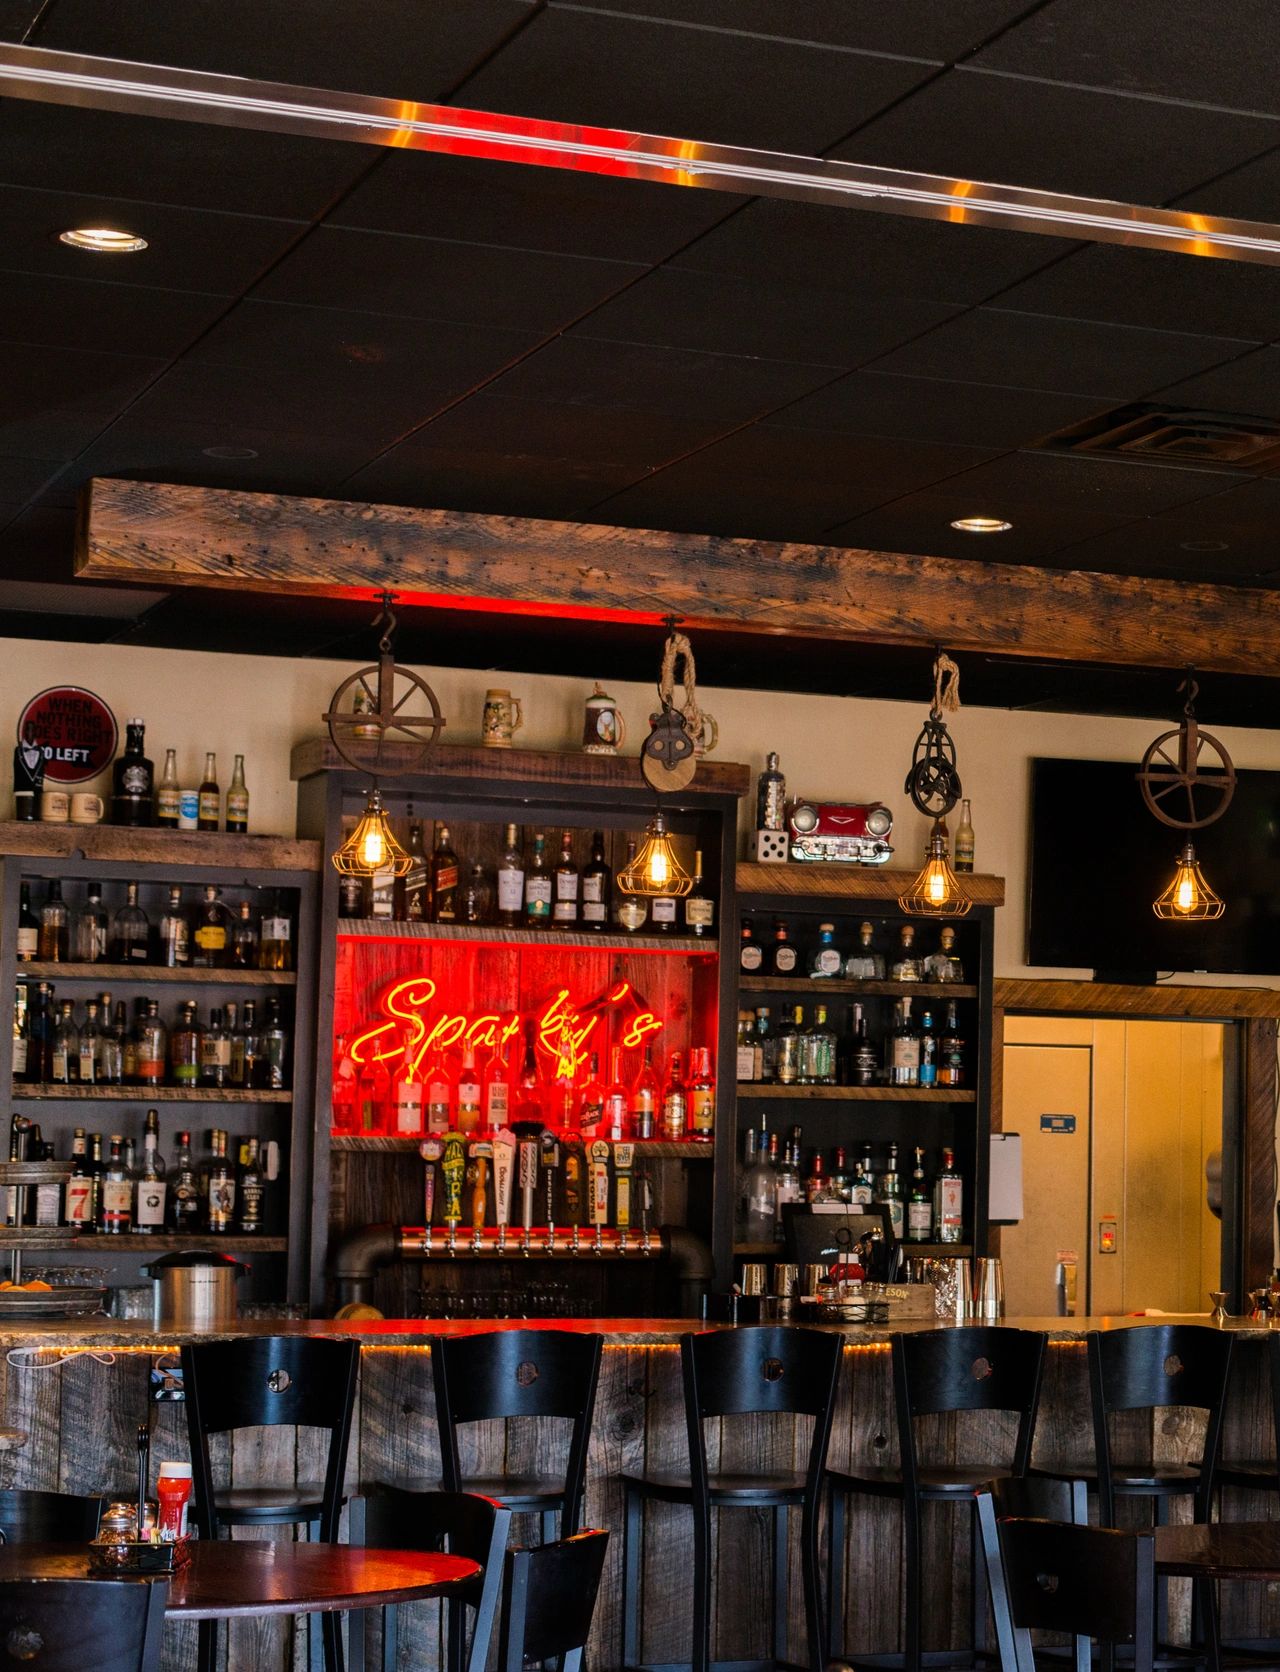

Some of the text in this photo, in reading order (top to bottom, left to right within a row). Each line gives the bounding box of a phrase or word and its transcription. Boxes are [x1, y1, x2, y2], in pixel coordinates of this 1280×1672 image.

[48, 696, 93, 713] WHEN
[36, 710, 102, 728] NOTHING
[67, 728, 113, 745] RIGHT
[56, 747, 90, 762] LEFT
[70, 1188, 89, 1219] 7
[885, 1287, 909, 1300] ESON
